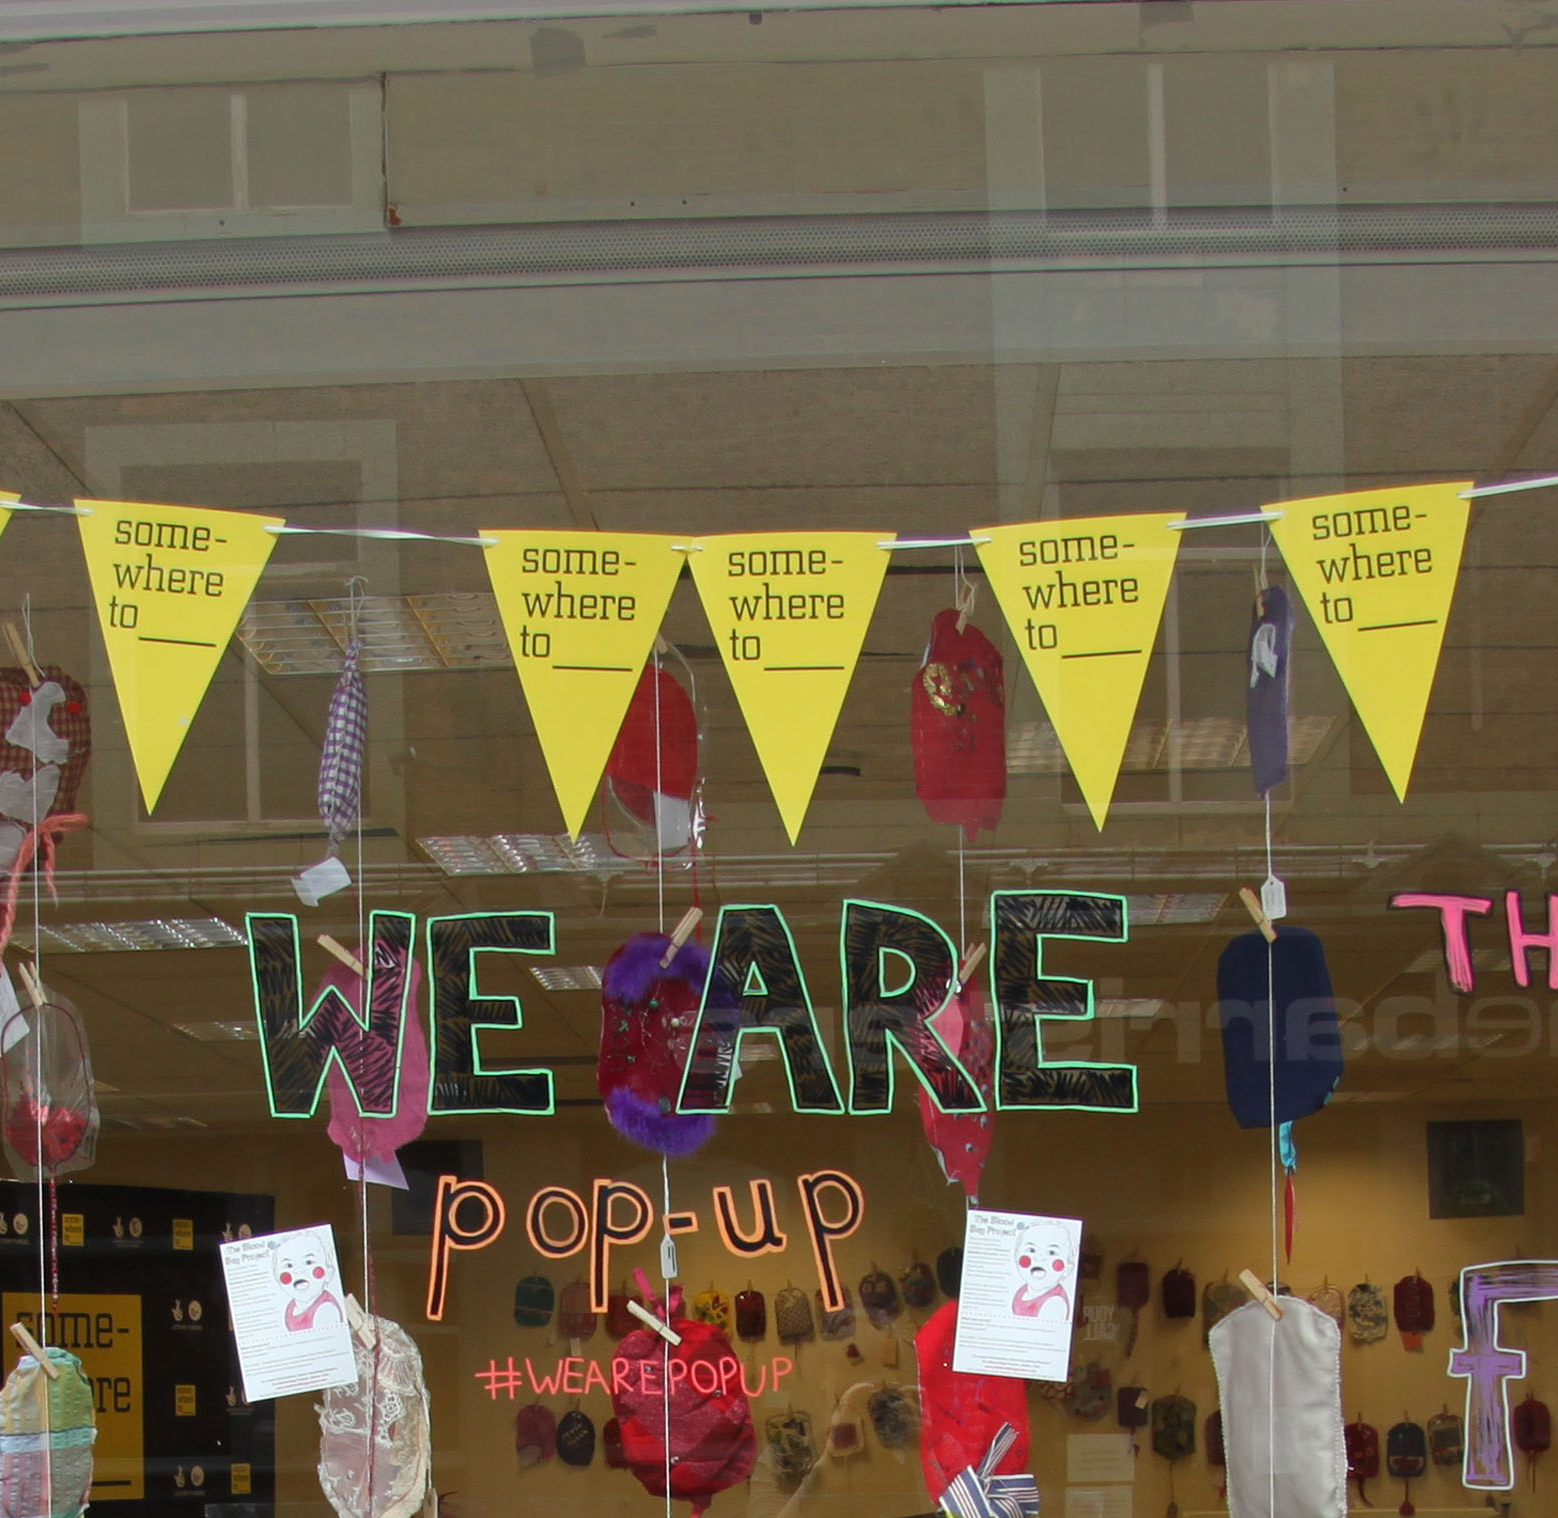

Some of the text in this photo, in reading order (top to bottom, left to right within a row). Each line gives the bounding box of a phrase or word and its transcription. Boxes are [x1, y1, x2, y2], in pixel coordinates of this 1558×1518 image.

[113, 518, 228, 553] some-
[1312, 504, 1427, 541] some-
[521, 545, 637, 576] some-
[727, 547, 843, 577] some-
[1019, 533, 1135, 568] some-
[1316, 542, 1433, 585] where
[112, 556, 224, 596] where
[1022, 571, 1139, 612] where
[521, 584, 636, 622] where
[729, 583, 845, 622] where
[244, 890, 1139, 1119] WE ARE
[426, 1169, 865, 1321] pop-up
[474, 1354, 794, 1403] #WEAREPOPUP
